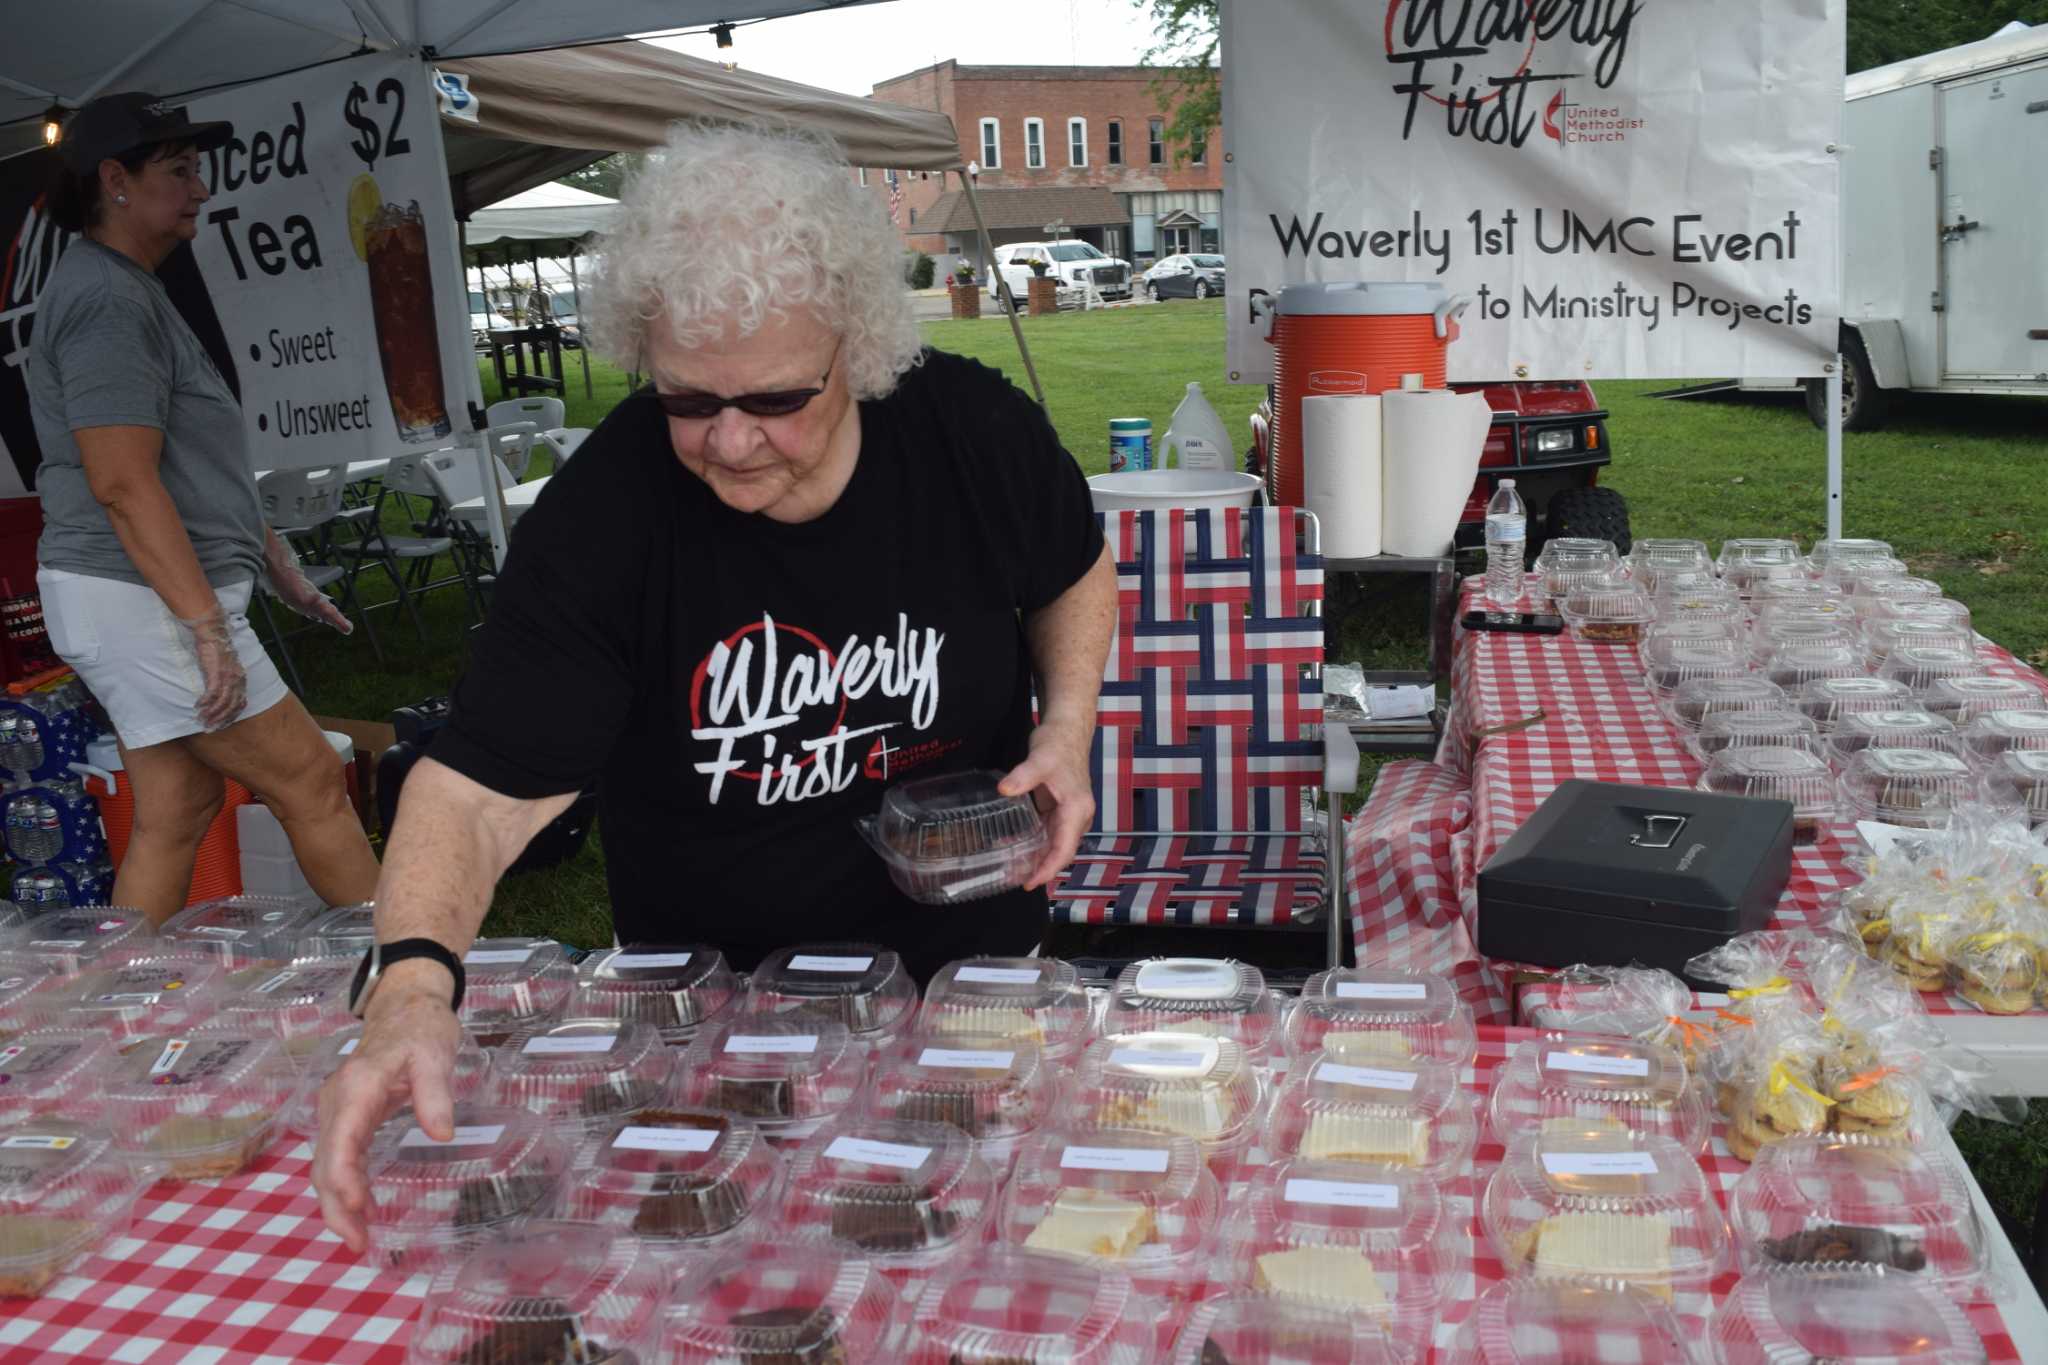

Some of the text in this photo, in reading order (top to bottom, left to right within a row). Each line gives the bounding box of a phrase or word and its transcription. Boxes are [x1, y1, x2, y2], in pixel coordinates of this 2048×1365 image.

[344, 78, 411, 172] $2
[1387, 47, 1584, 148] First
[1566, 107, 1619, 118] United
[1566, 118, 1645, 130] Methodist
[1566, 131, 1625, 143] Church
[208, 205, 323, 281] Tea
[1269, 207, 1801, 275] Waverly 1st UMC Event
[1477, 280, 1812, 332] to Ministry Projects
[268, 325, 337, 369] Sweet
[275, 393, 372, 439] Unsweet
[707, 610, 946, 731] Waverly
[691, 712, 903, 806] First
